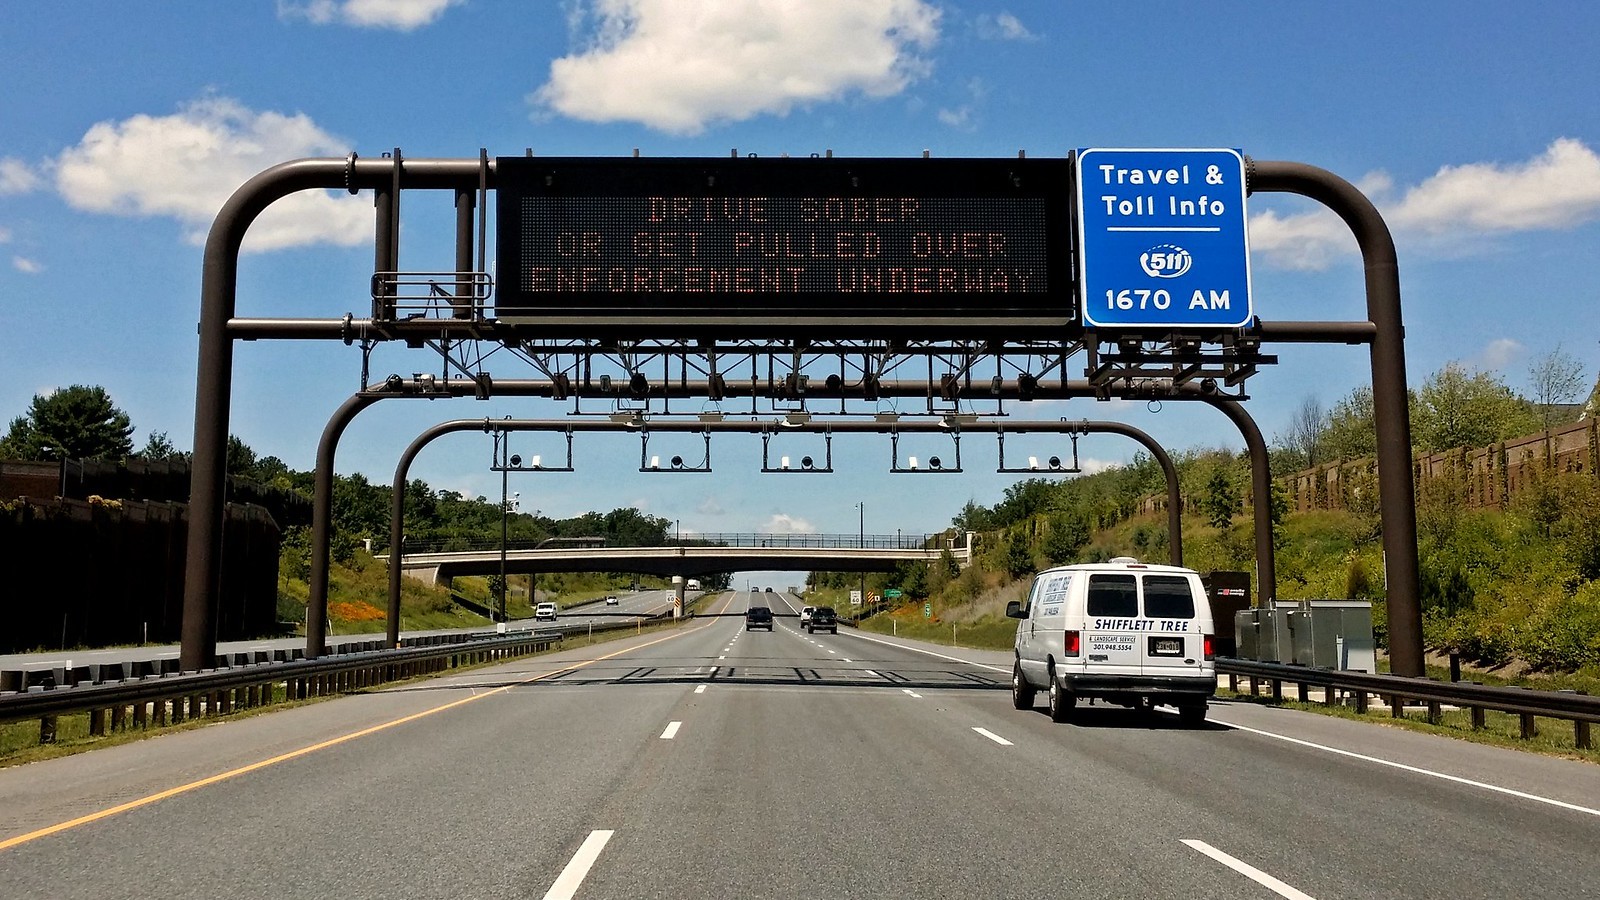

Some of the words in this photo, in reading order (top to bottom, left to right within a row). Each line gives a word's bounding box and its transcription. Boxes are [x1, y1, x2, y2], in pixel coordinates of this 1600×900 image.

[1099, 165, 1189, 185] Travel
[1205, 165, 1223, 185] &
[648, 197, 767, 222] DRIVE
[801, 197, 920, 222] SOBER
[1101, 195, 1154, 216] Toll
[1170, 196, 1225, 216] Info
[557, 232, 601, 257] OR
[633, 232, 700, 257] GET
[735, 232, 880, 257] PULLED
[912, 232, 1007, 257] OVER
[1150, 253, 1182, 270] 511
[531, 267, 805, 293] ENFORCEMENT
[837, 267, 1034, 293] UNDERWAY
[1106, 290, 1171, 310] 1670
[1188, 290, 1230, 310] AM
[1094, 619, 1154, 631] SHIFFLETT
[1160, 620, 1189, 631] TREE
